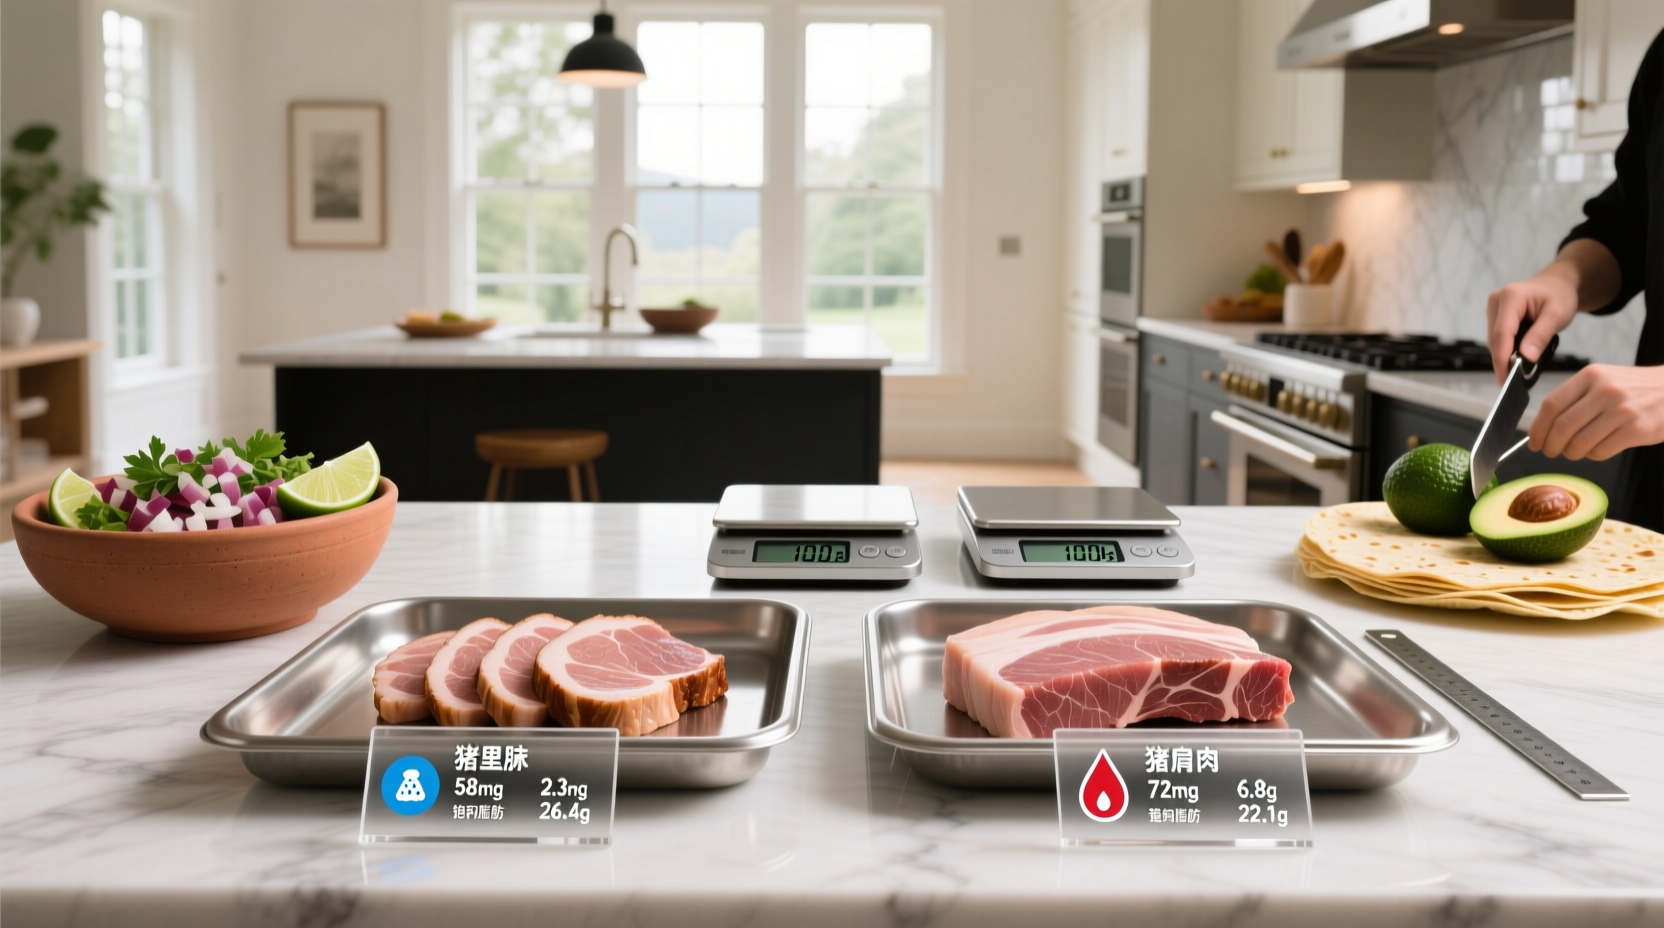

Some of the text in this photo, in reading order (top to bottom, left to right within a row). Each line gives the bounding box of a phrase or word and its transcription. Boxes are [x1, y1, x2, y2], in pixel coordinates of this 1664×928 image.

[1145, 745, 1219, 773] 猪肩肉
[454, 777, 504, 801] 58mg
[1147, 779, 1199, 803] 72mg
[1236, 778, 1277, 803] 6.8g
[538, 801, 590, 825] 26.4g
[1238, 804, 1288, 828] 22.1g
